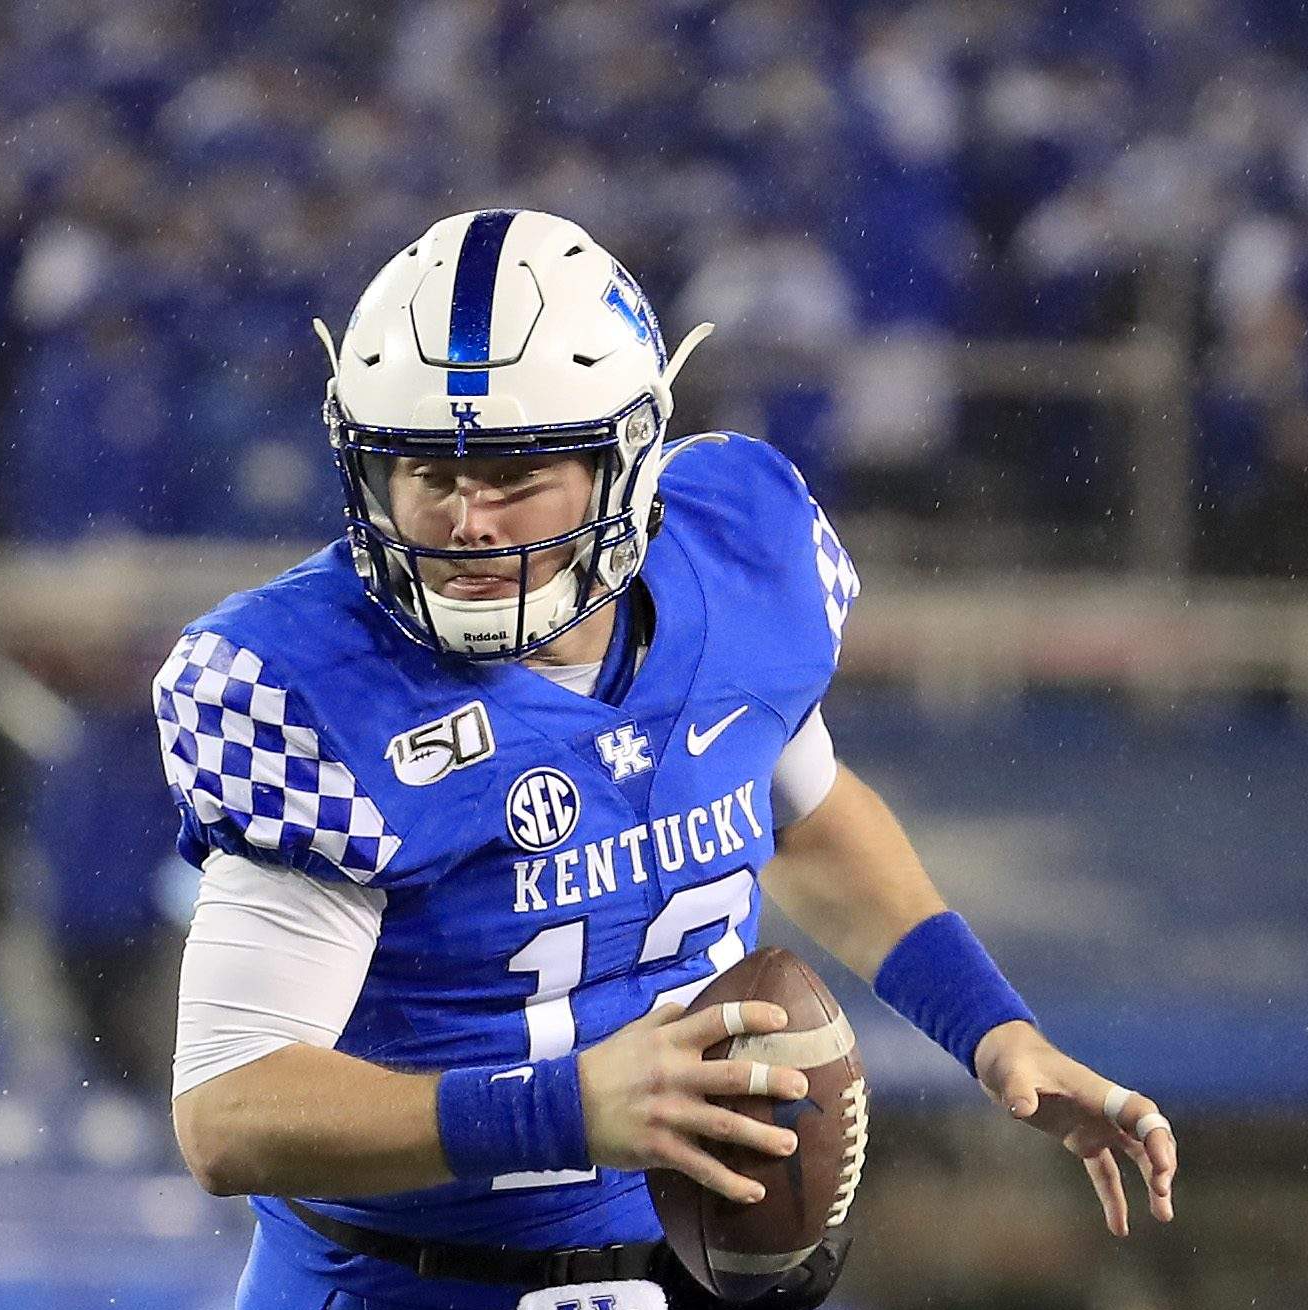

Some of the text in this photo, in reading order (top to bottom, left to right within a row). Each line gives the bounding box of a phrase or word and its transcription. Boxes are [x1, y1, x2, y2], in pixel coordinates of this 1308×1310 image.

[463, 631, 507, 642] Riddell
[390, 703, 492, 784] 150
[596, 722, 654, 783] UK
[511, 773, 574, 847] SEC
[513, 779, 764, 913] KENTUCKY
